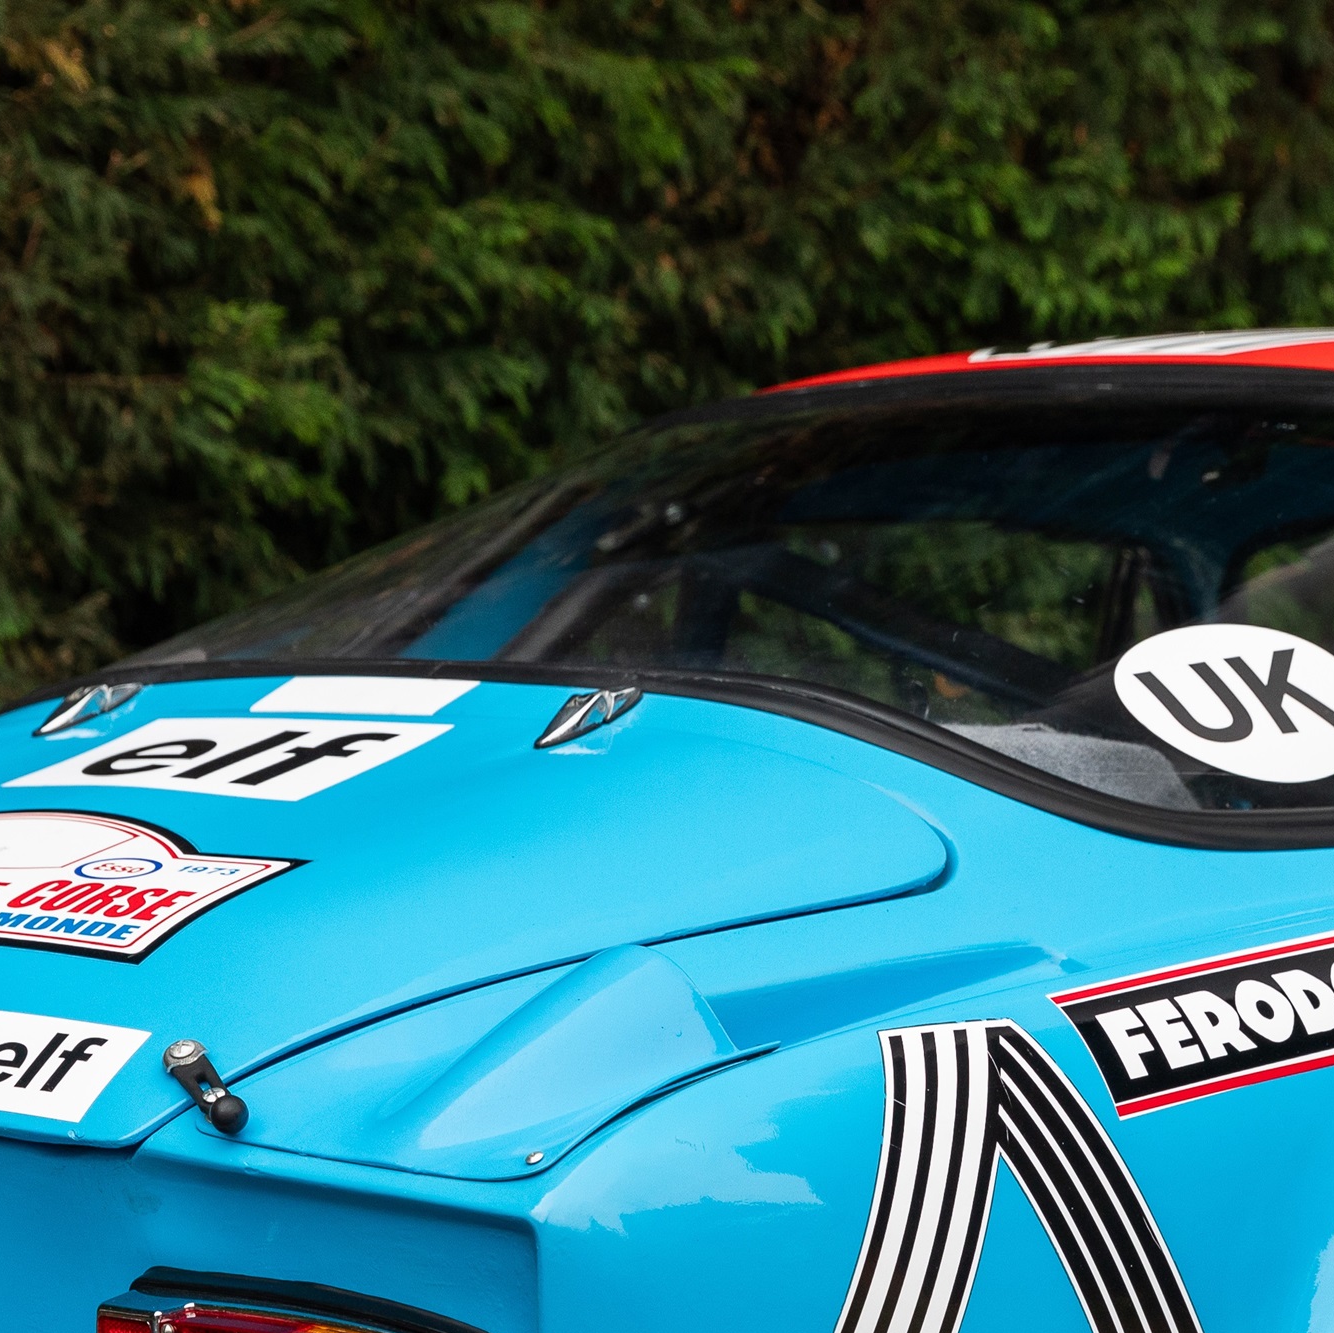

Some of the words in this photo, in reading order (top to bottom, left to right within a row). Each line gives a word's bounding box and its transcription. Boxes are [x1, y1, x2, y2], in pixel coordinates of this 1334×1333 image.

[82, 730, 400, 786] elf
[92, 862, 143, 874] Esso
[177, 865, 241, 877] 1973
[7, 879, 197, 921] CORSE
